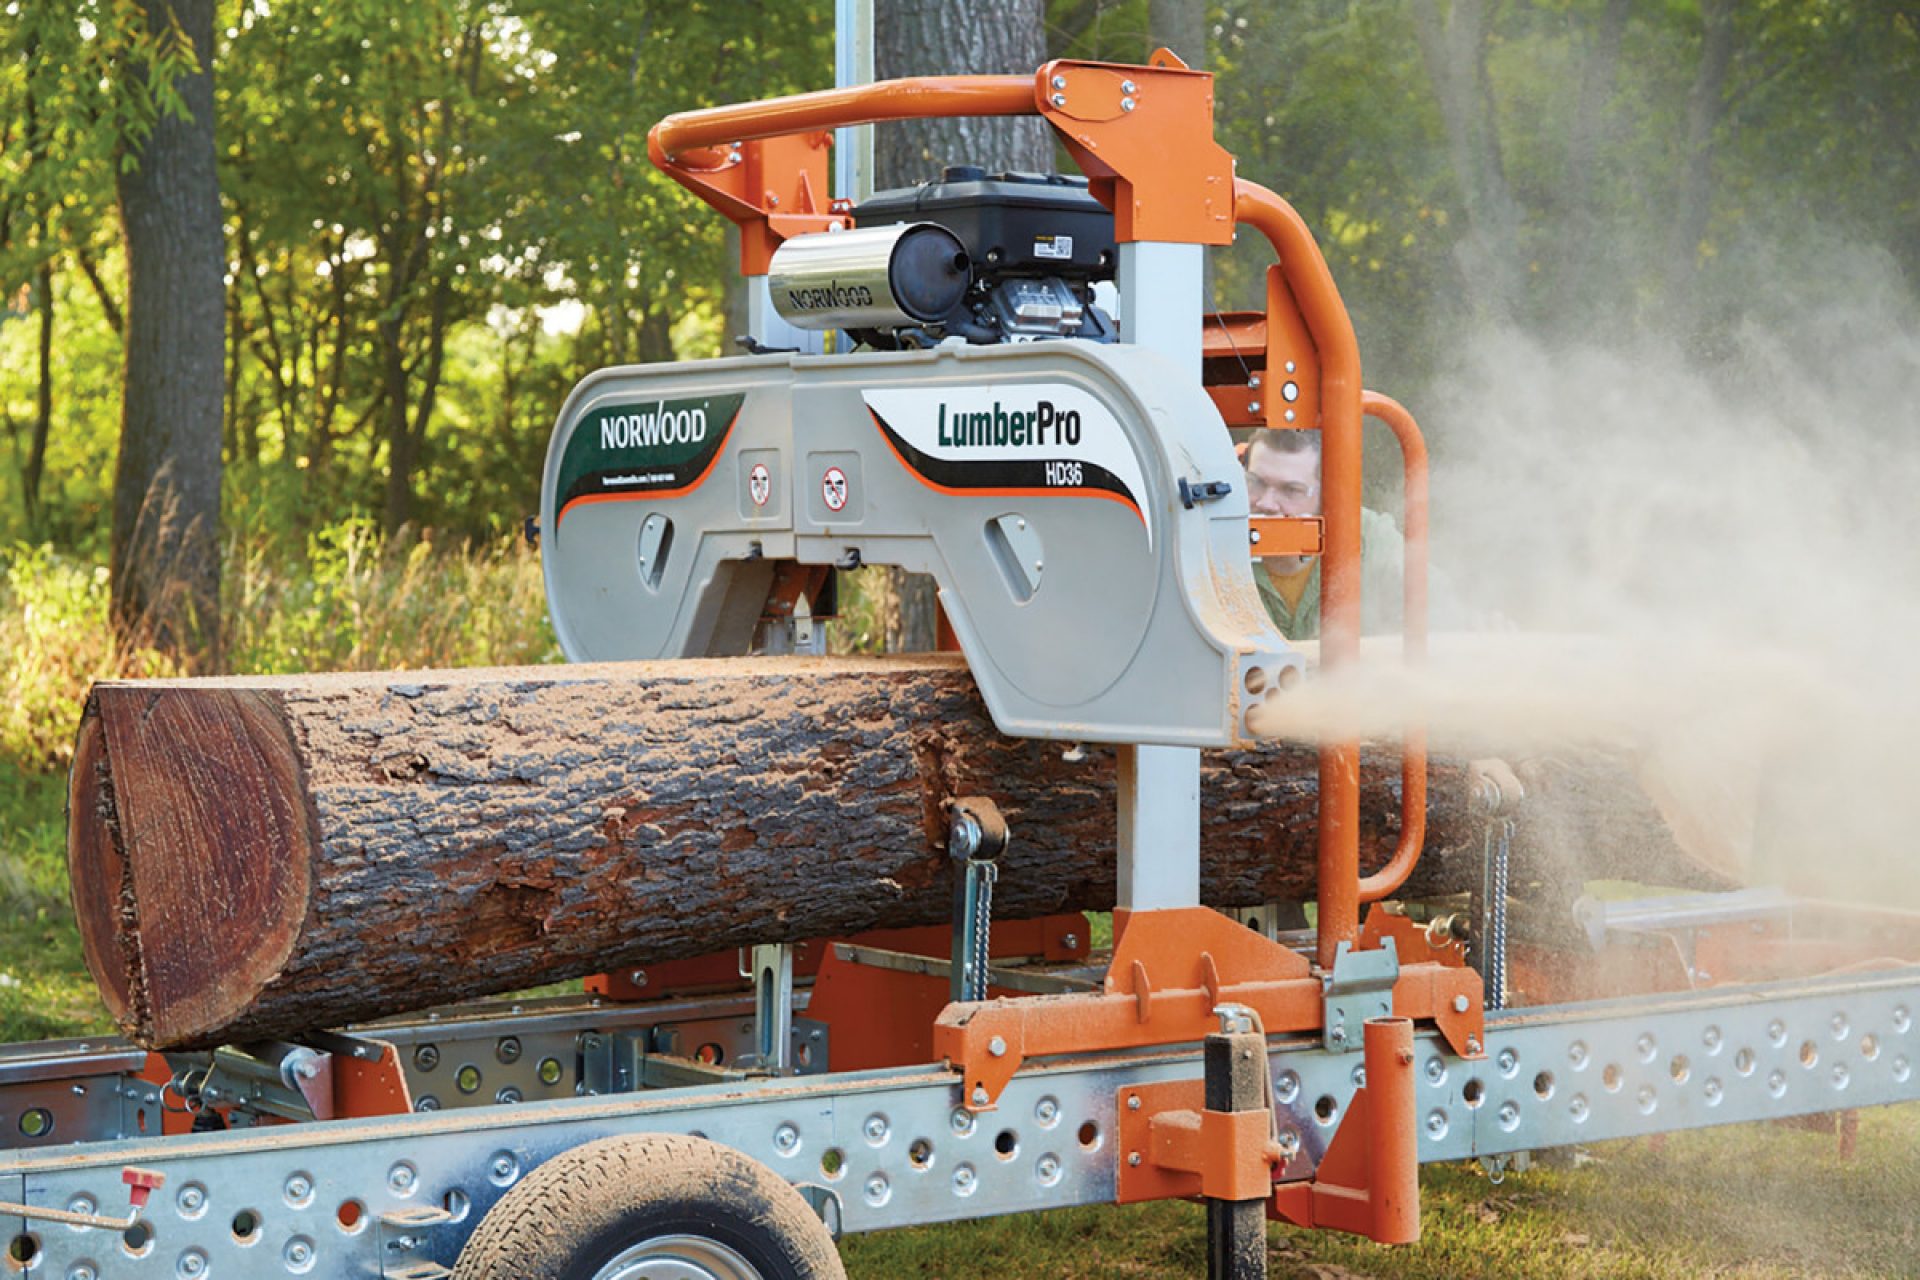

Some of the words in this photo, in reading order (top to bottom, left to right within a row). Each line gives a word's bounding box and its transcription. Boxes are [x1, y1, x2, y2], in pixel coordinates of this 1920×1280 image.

[789, 280, 873, 311] NORWOOD
[600, 400, 707, 450] NORWOOD
[938, 400, 1081, 447] LumberPro
[1045, 462, 1083, 486] HD36
